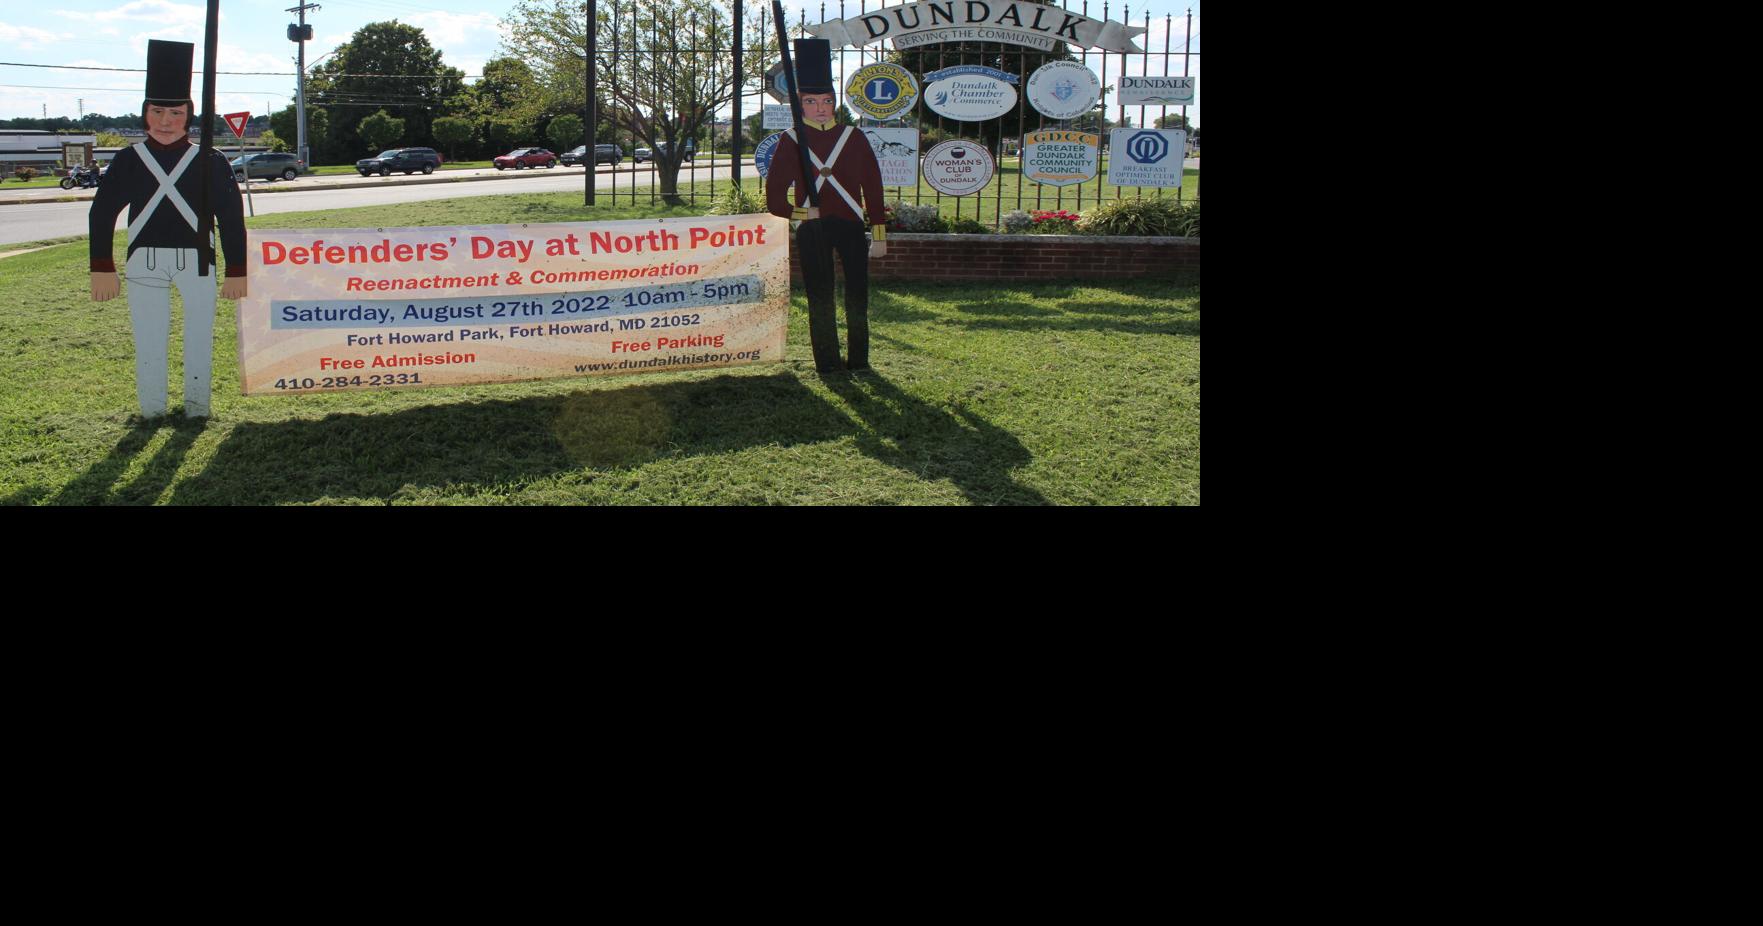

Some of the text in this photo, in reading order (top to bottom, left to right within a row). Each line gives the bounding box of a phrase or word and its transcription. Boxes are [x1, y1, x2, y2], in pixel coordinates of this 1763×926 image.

[861, 0, 1088, 42] DUNDALK
[898, 30, 1050, 48] SERVING THE COMMUNITY
[941, 67, 983, 77] established
[872, 80, 893, 100] L
[952, 82, 998, 90] Dundalk
[1121, 77, 1191, 89] DUNDALK
[951, 89, 1005, 98] Chamber
[952, 97, 1002, 105] Commerce
[757, 134, 781, 159] DUNDAL
[1034, 132, 1090, 144] GDCC
[945, 166, 972, 174] CLUB
[1029, 159, 1093, 167] COMMUNITY
[1039, 166, 1082, 174] COUNCIL
[1122, 165, 1168, 173] BREAKFAST
[262, 224, 766, 266] Defenders' Day at North Point
[346, 262, 700, 293] Reenactment & Commemoration
[281, 305, 396, 324] Saturday,
[403, 303, 484, 323] August
[491, 301, 544, 318] 27th
[551, 295, 610, 315] 2022
[624, 289, 685, 308] 10am
[703, 282, 749, 302] 5pm
[347, 313, 700, 347] Fort Howard Park, Fort Howard, MD 21052
[611, 333, 725, 354] Free Parking
[320, 352, 476, 371] Free Admission
[574, 348, 761, 373] www.dundalkhistory.org
[274, 372, 423, 390] 410-284-2331
